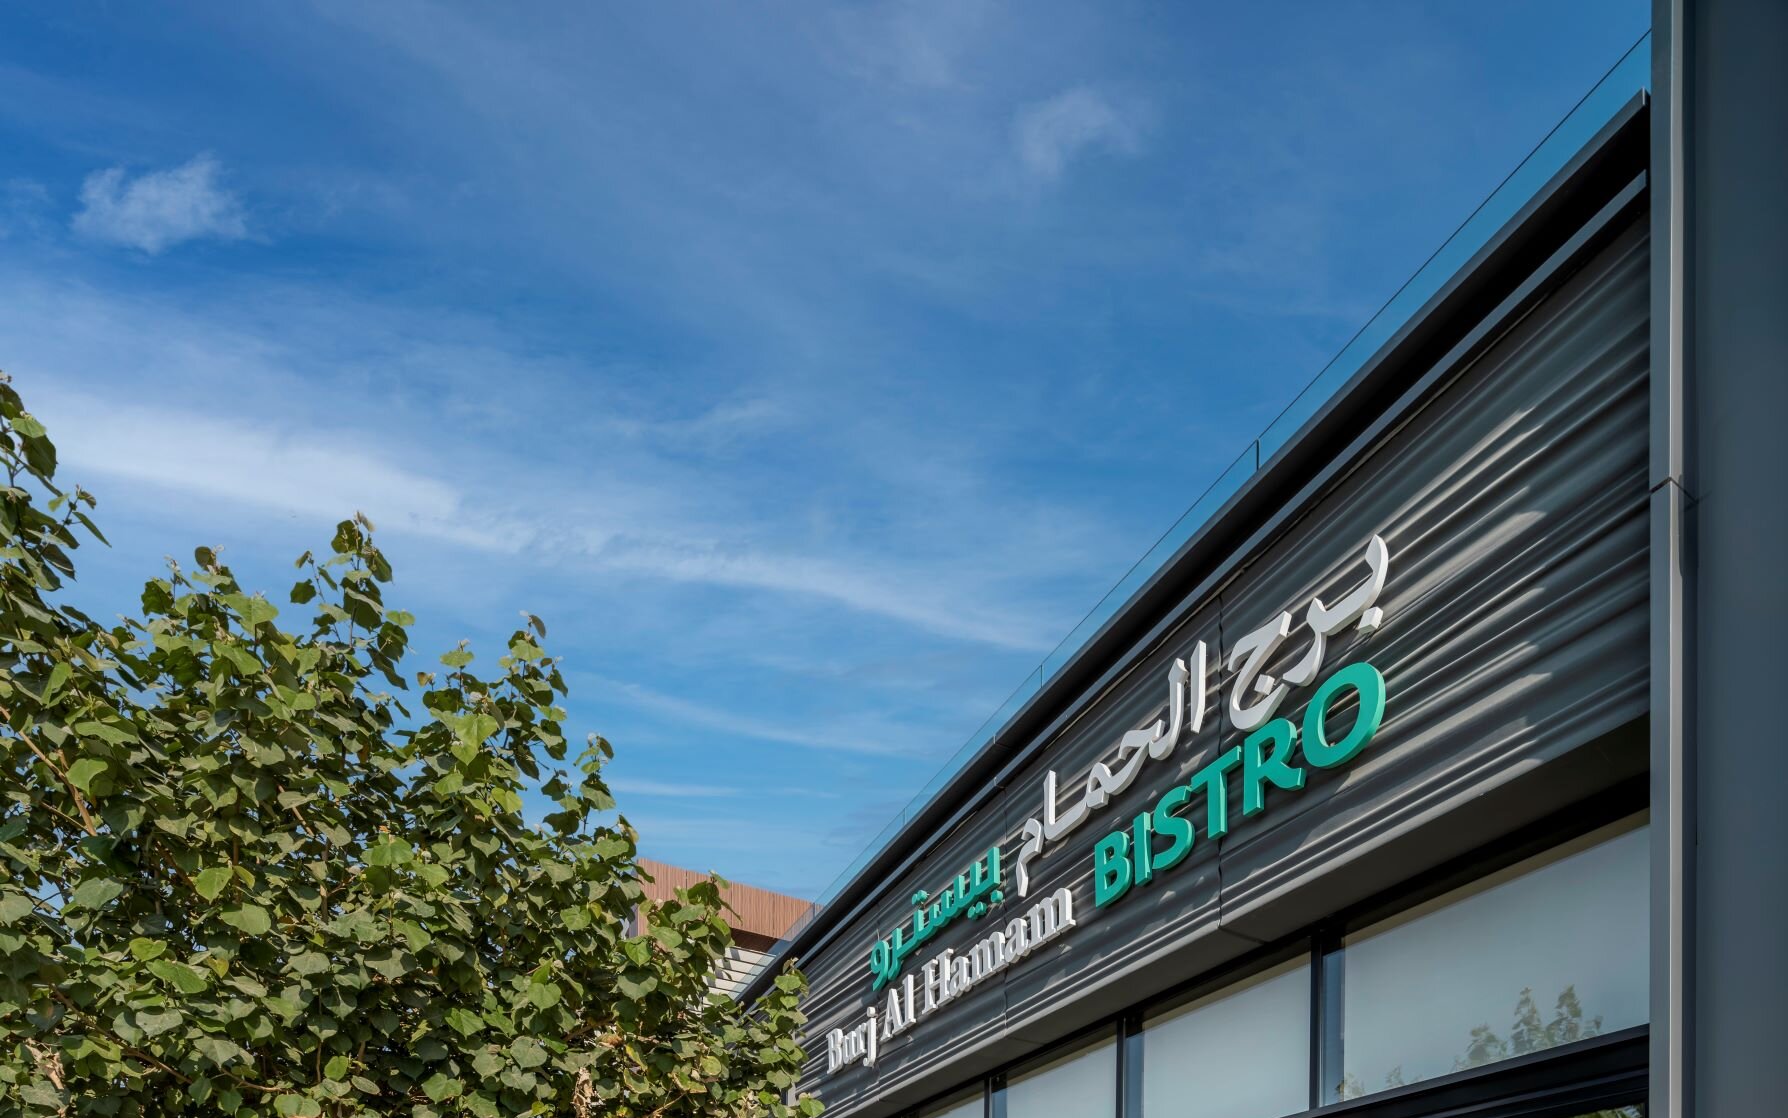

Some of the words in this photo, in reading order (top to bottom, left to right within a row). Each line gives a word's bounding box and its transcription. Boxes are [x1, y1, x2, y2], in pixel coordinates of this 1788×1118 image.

[1228, 534, 1389, 732] برج
[826, 1005, 878, 1075] Burj
[880, 973, 917, 1042] Al
[921, 887, 1077, 1015] Hamam
[1094, 661, 1387, 909] BISTRO
[1014, 639, 1207, 898] الحمام
[870, 846, 1004, 992] بيسترو
